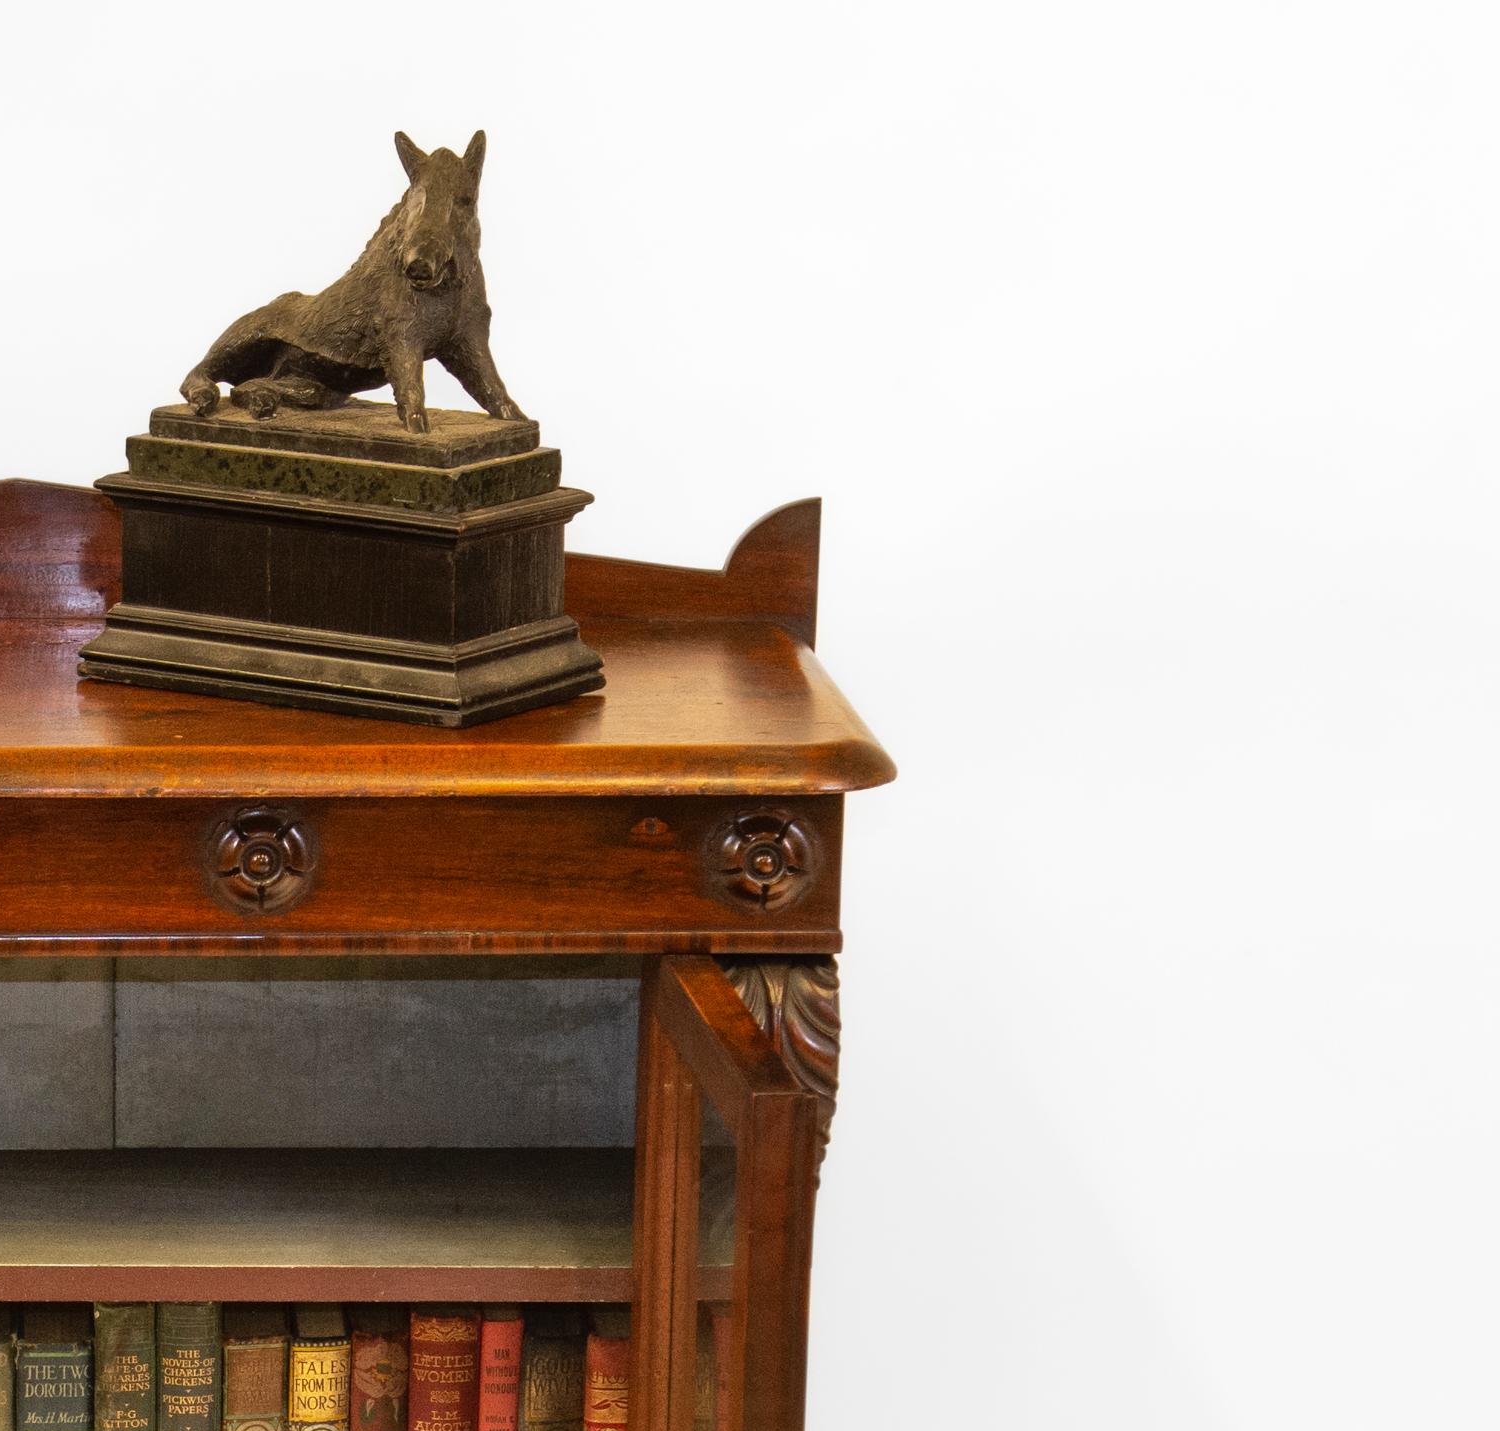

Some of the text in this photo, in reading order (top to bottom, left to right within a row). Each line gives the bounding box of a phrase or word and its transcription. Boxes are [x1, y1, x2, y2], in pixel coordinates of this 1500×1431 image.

[115, 1356, 138, 1365] THE
[176, 1350, 201, 1359] THE
[413, 1353, 474, 1368] LITTLE
[493, 1348, 511, 1361] MAN
[24, 1364, 57, 1380] THE
[298, 1358, 347, 1375] TALES
[485, 1365, 518, 1378] WITHOUT
[163, 1376, 213, 1387] DICKENS
[412, 1367, 475, 1384] WOMEN
[295, 1375, 348, 1393] FROM THE
[484, 1382, 518, 1395] HONOUR
[163, 1394, 214, 1406] PICKWICK
[296, 1393, 348, 1411] NORSE
[168, 1404, 210, 1415] PAPERS
